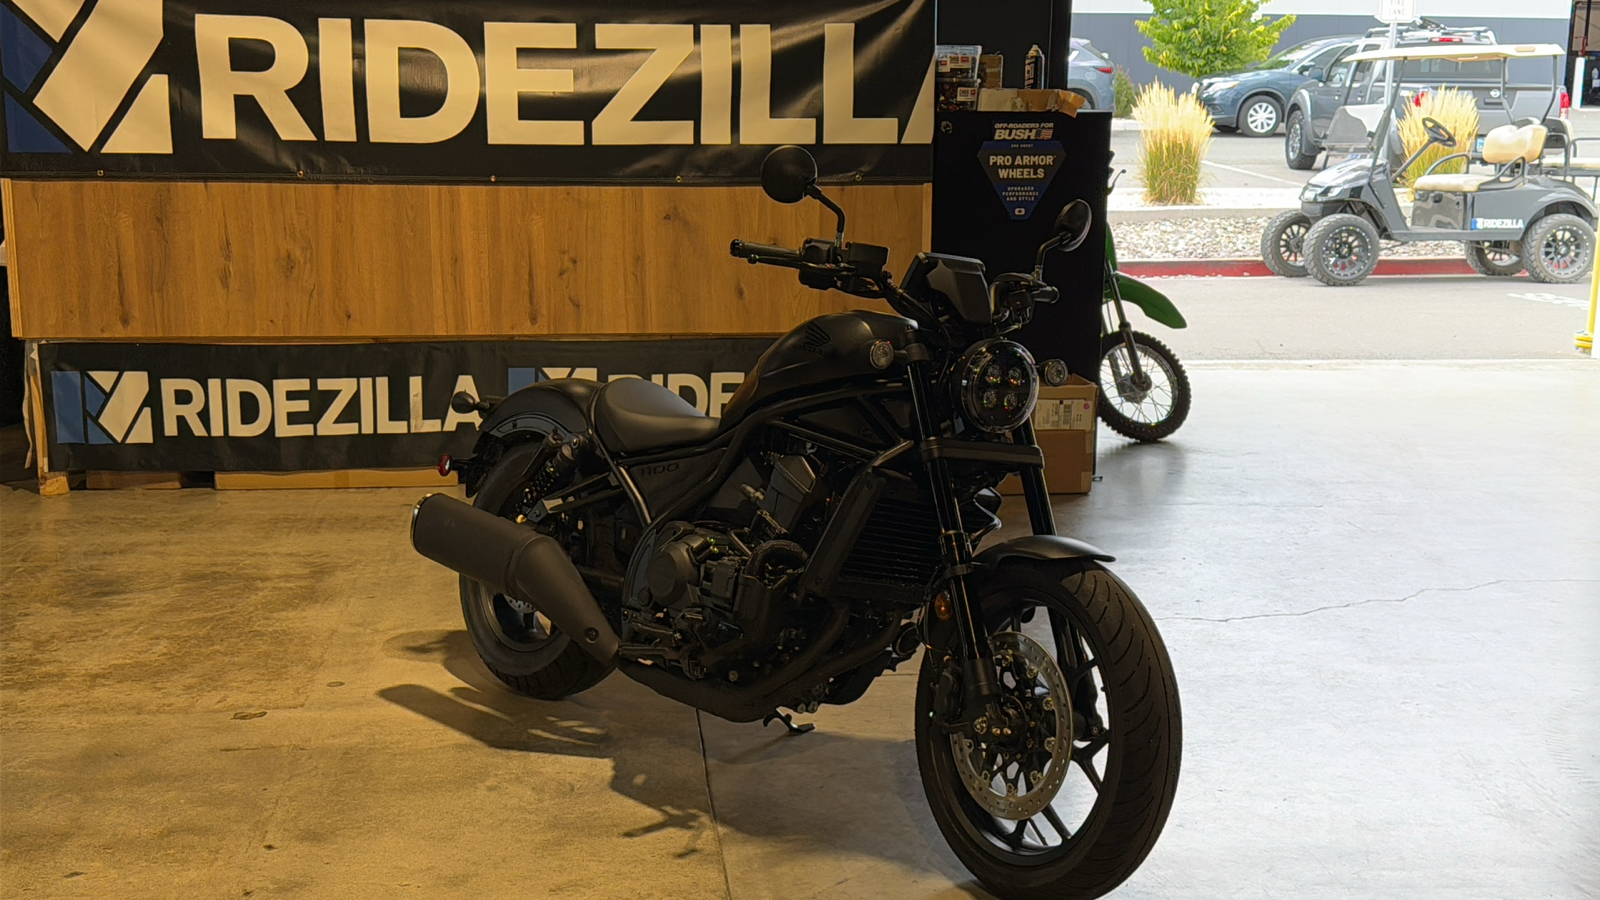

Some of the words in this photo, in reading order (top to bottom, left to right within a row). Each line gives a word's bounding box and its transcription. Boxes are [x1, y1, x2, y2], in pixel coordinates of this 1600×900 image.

[994, 129, 1037, 140] BUSH
[989, 155, 1013, 166] PRO
[1014, 155, 1054, 166] ARMOR
[998, 168, 1045, 179] WHEELS
[1483, 218, 1524, 229] RIDEZILLA
[161, 375, 484, 438] RIDEZILLA
[640, 463, 679, 476] 1100
